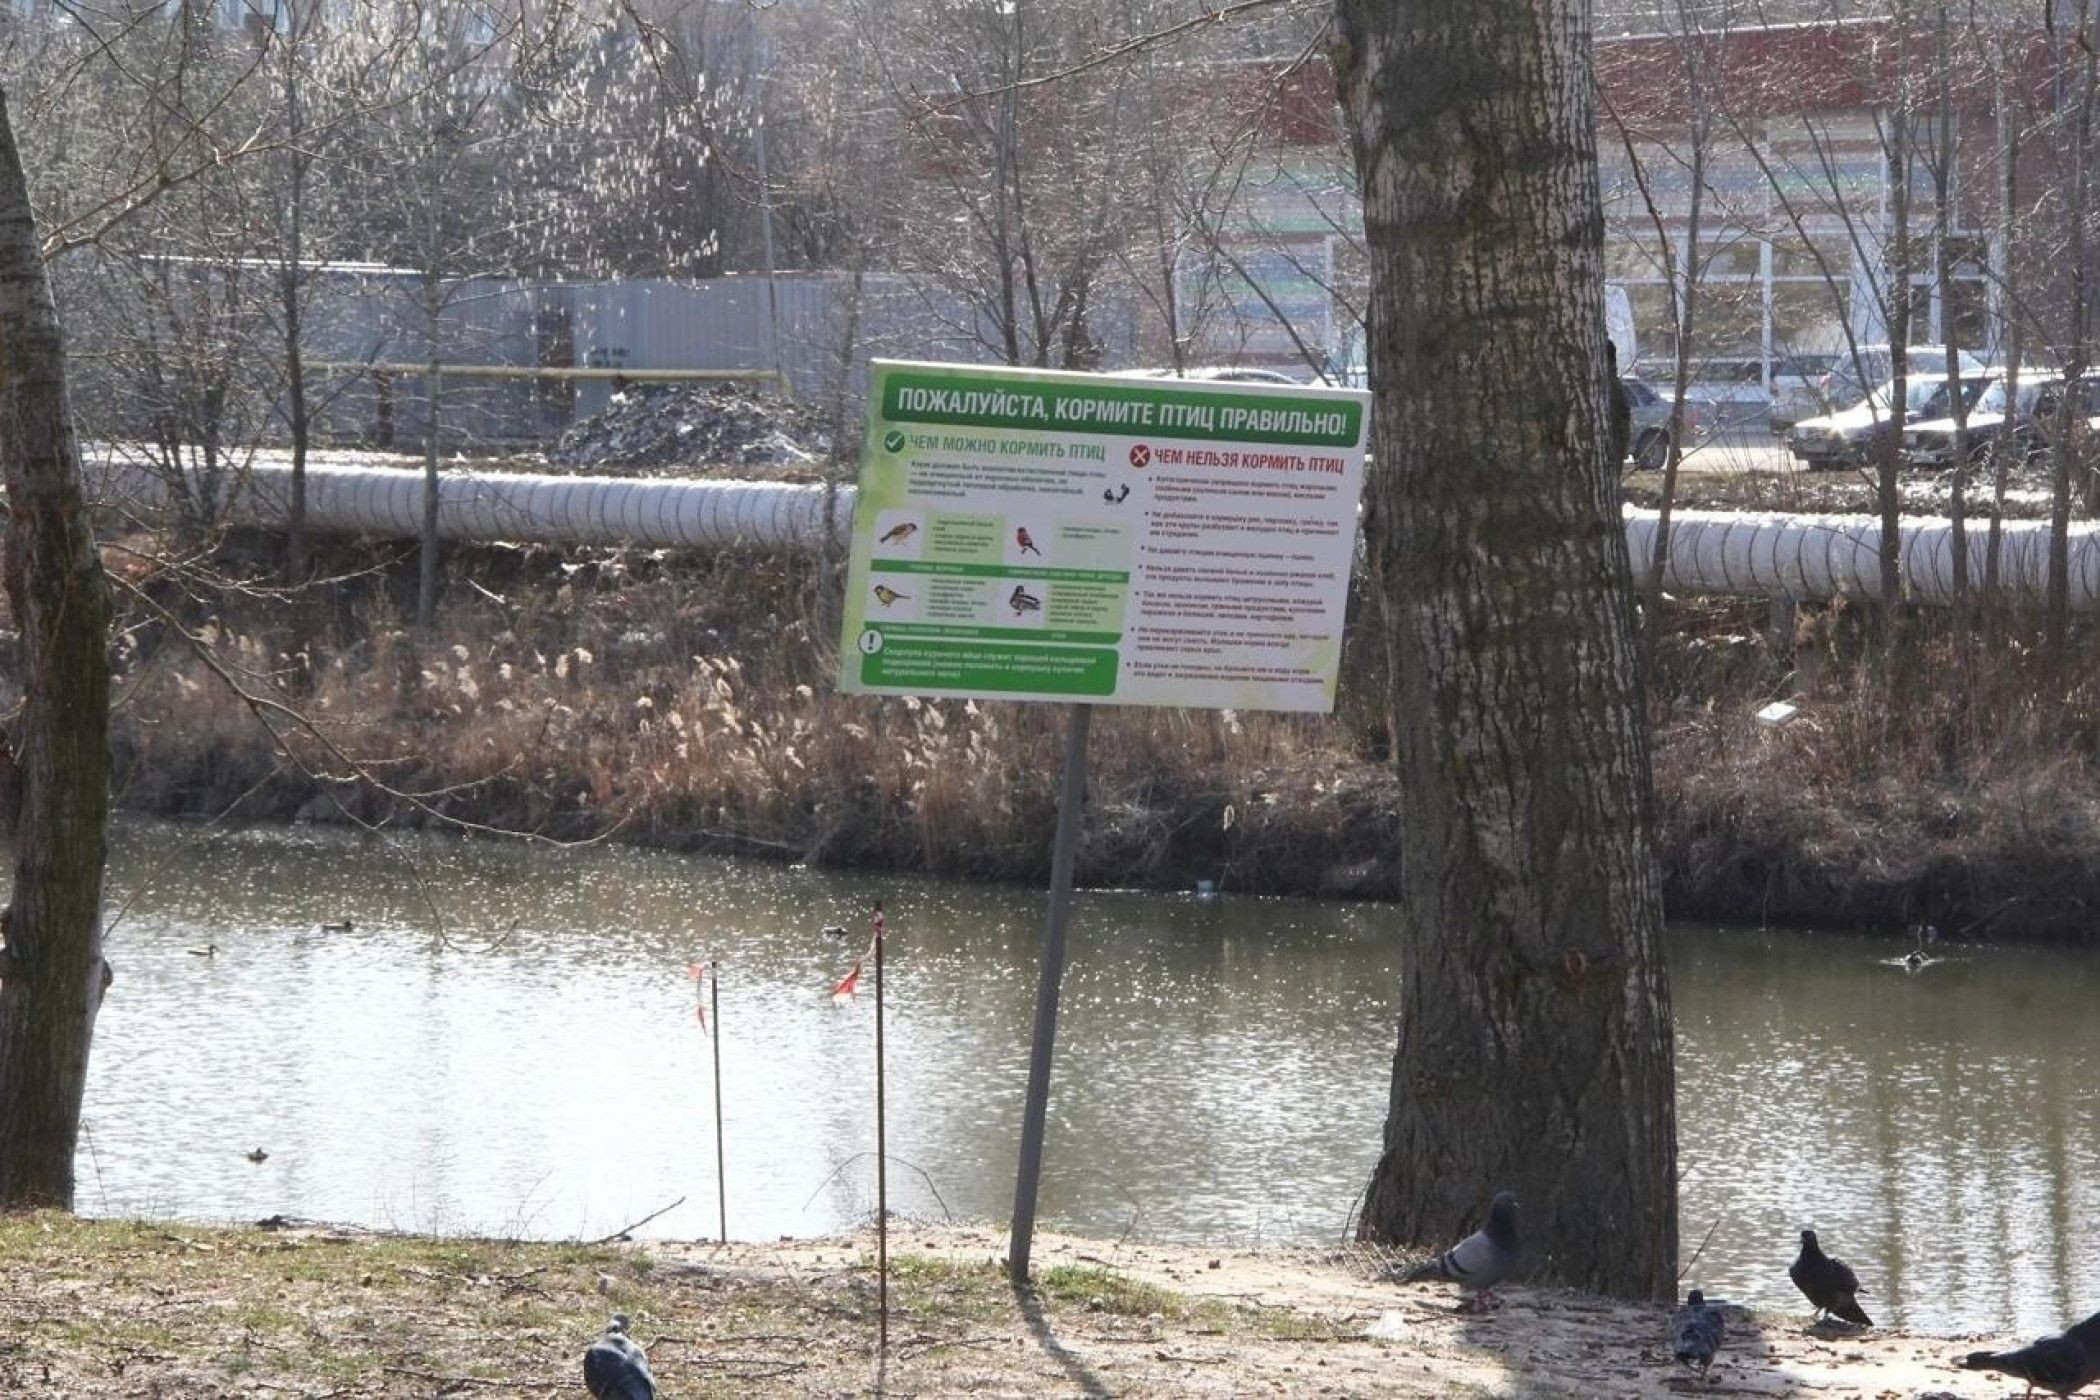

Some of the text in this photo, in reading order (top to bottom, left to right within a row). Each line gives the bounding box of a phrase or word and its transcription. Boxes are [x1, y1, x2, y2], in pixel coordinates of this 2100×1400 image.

[898, 387, 1347, 436] ПОЖАЛУЙСТА, КОРМИТЕ ПТИЦ ПРАВИЛЬНО!
[909, 434, 1105, 462] ЧЕМ МОЖНО КОРМИТЬ ПТИЦ
[1154, 449, 1345, 475] ЧЕМ НЕЛЬЗЯ КОРМИТЬ ПТИЦ
